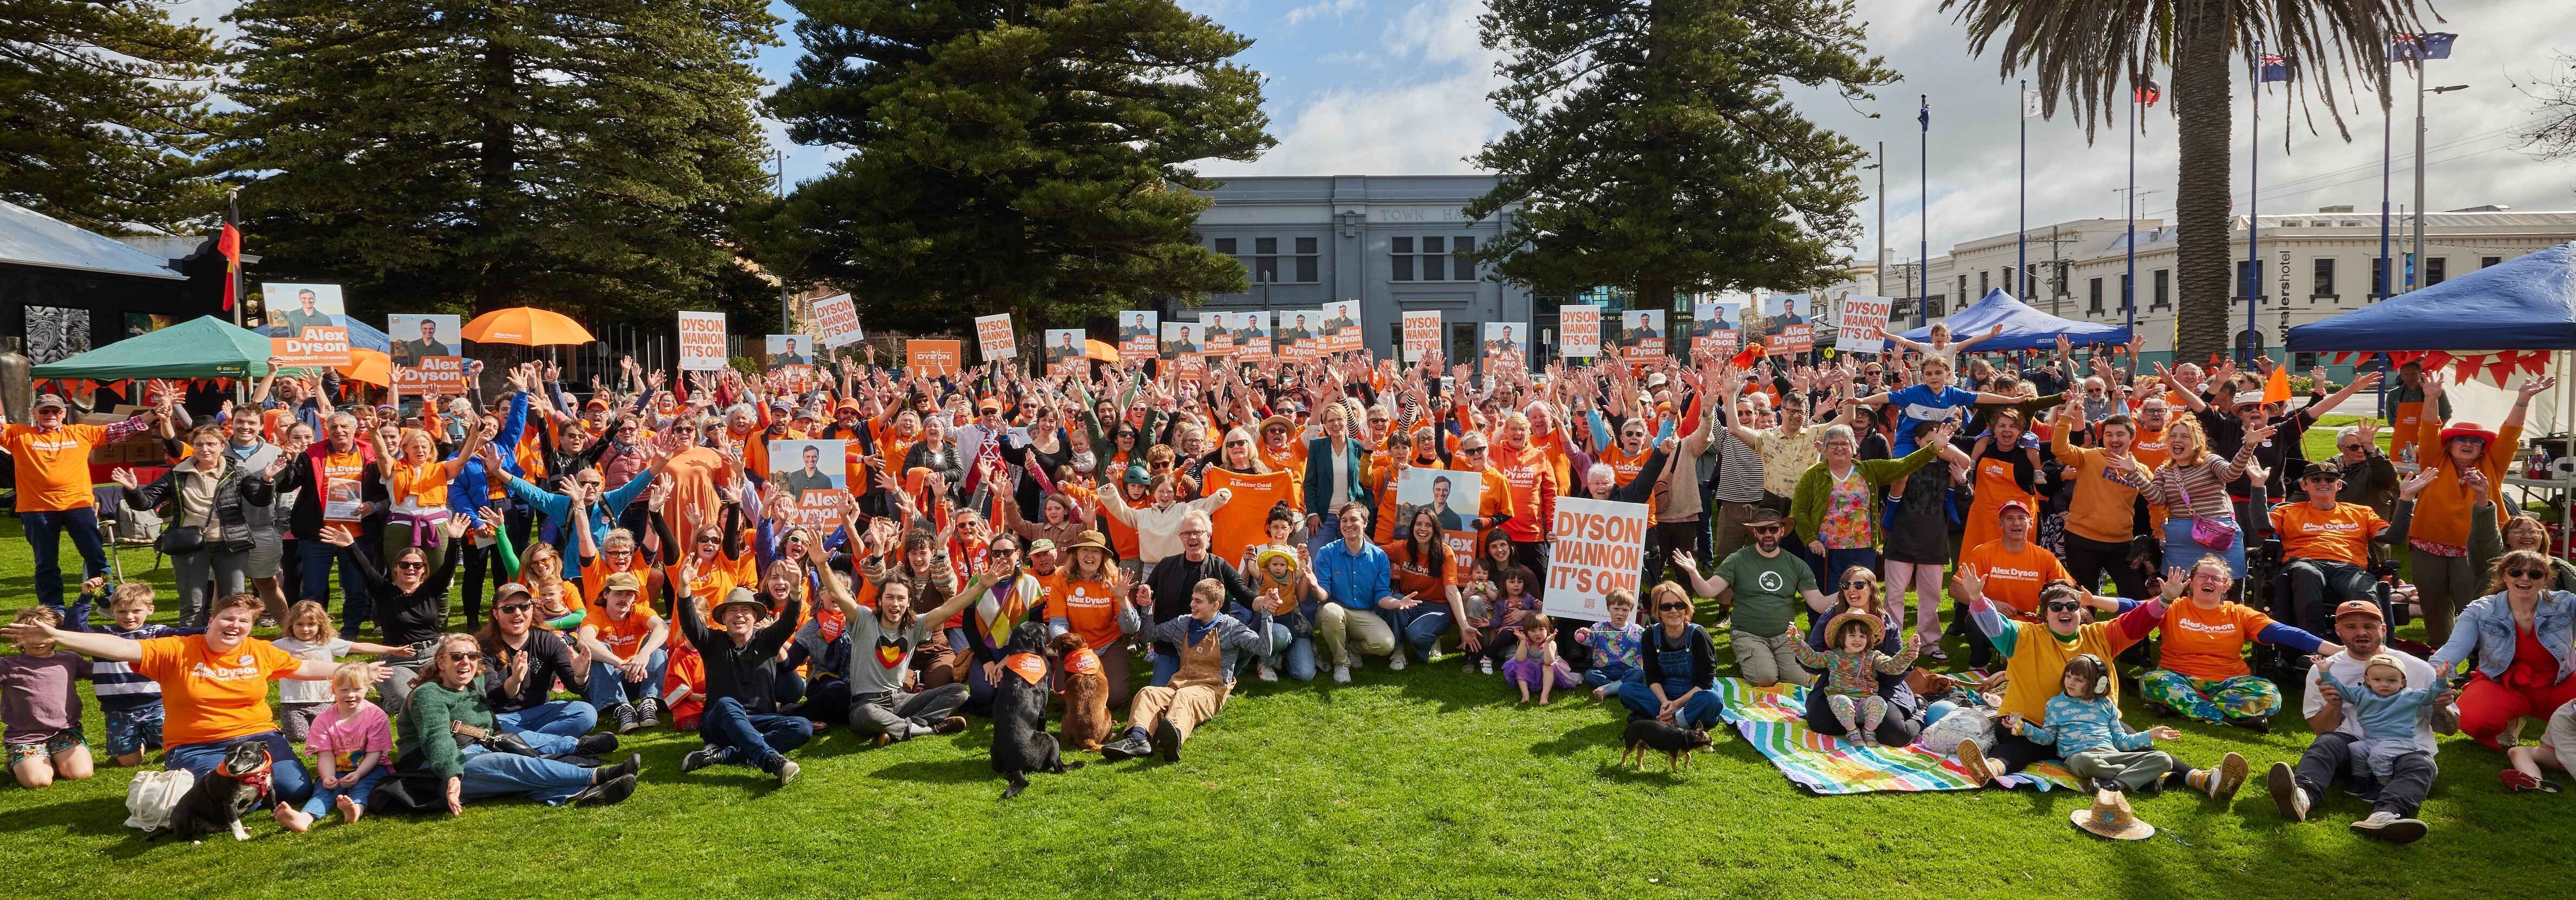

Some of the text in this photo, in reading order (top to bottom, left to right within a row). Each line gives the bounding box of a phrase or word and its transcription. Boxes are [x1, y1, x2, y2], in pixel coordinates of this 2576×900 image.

[1381, 209, 1425, 220] TOWN
[816, 299, 852, 318] DYSON
[1845, 301, 1889, 316] DYSON
[820, 310, 855, 328] WANNON
[1562, 311, 1599, 323] DYSON
[1843, 315, 1886, 329] WANNON
[682, 318, 724, 332] DYSON
[978, 319, 1010, 333] DYSON
[1404, 317, 1439, 329] DYSON
[1562, 323, 1598, 334] WANNON
[304, 329, 346, 341] Alex
[823, 321, 858, 338] IT'S ON!
[1405, 329, 1440, 339] WANNON
[1784, 327, 1809, 336] Alex
[1840, 327, 1861, 339] IT'S
[683, 332, 724, 345] WANNON
[980, 330, 1012, 342] WANNON
[1331, 336, 1361, 344] Dyson
[1562, 335, 1598, 345] IT'S ON!
[1774, 336, 1810, 345] Dyson
[286, 340, 346, 356] Dyson
[982, 339, 1014, 351] IT'S ON!
[1126, 343, 1155, 351] Dyson
[1206, 342, 1232, 350] Dyson
[1294, 340, 1316, 348] Alex
[1405, 340, 1440, 351] IT'S ON!
[1641, 340, 1664, 348] Alex
[1700, 338, 1736, 347] Dyson
[683, 345, 724, 358] IT'S ON!
[1240, 346, 1270, 355] Dyson
[1286, 347, 1316, 356] Dyson
[1631, 347, 1664, 357] Dyson
[421, 358, 460, 370] Alex
[1056, 365, 1086, 374] Dyn
[1169, 362, 1199, 370] Dson
[404, 370, 460, 383] Dyson
[1503, 468, 1534, 479] Dyson
[1556, 511, 1644, 544] DYSON
[2325, 522, 2359, 530] Dyson
[1443, 533, 1473, 552] lex
[1555, 539, 1640, 571] WANNON
[1991, 566, 2038, 577] Alex Dyson
[1549, 565, 1637, 596] IT'S ON!
[1067, 595, 1110, 605] Alex Dyson
[823, 622, 838, 631] Dyson
[2180, 618, 2201, 628] Alex
[618, 634, 636, 644] yson
[194, 662, 258, 678] Al Dyson
